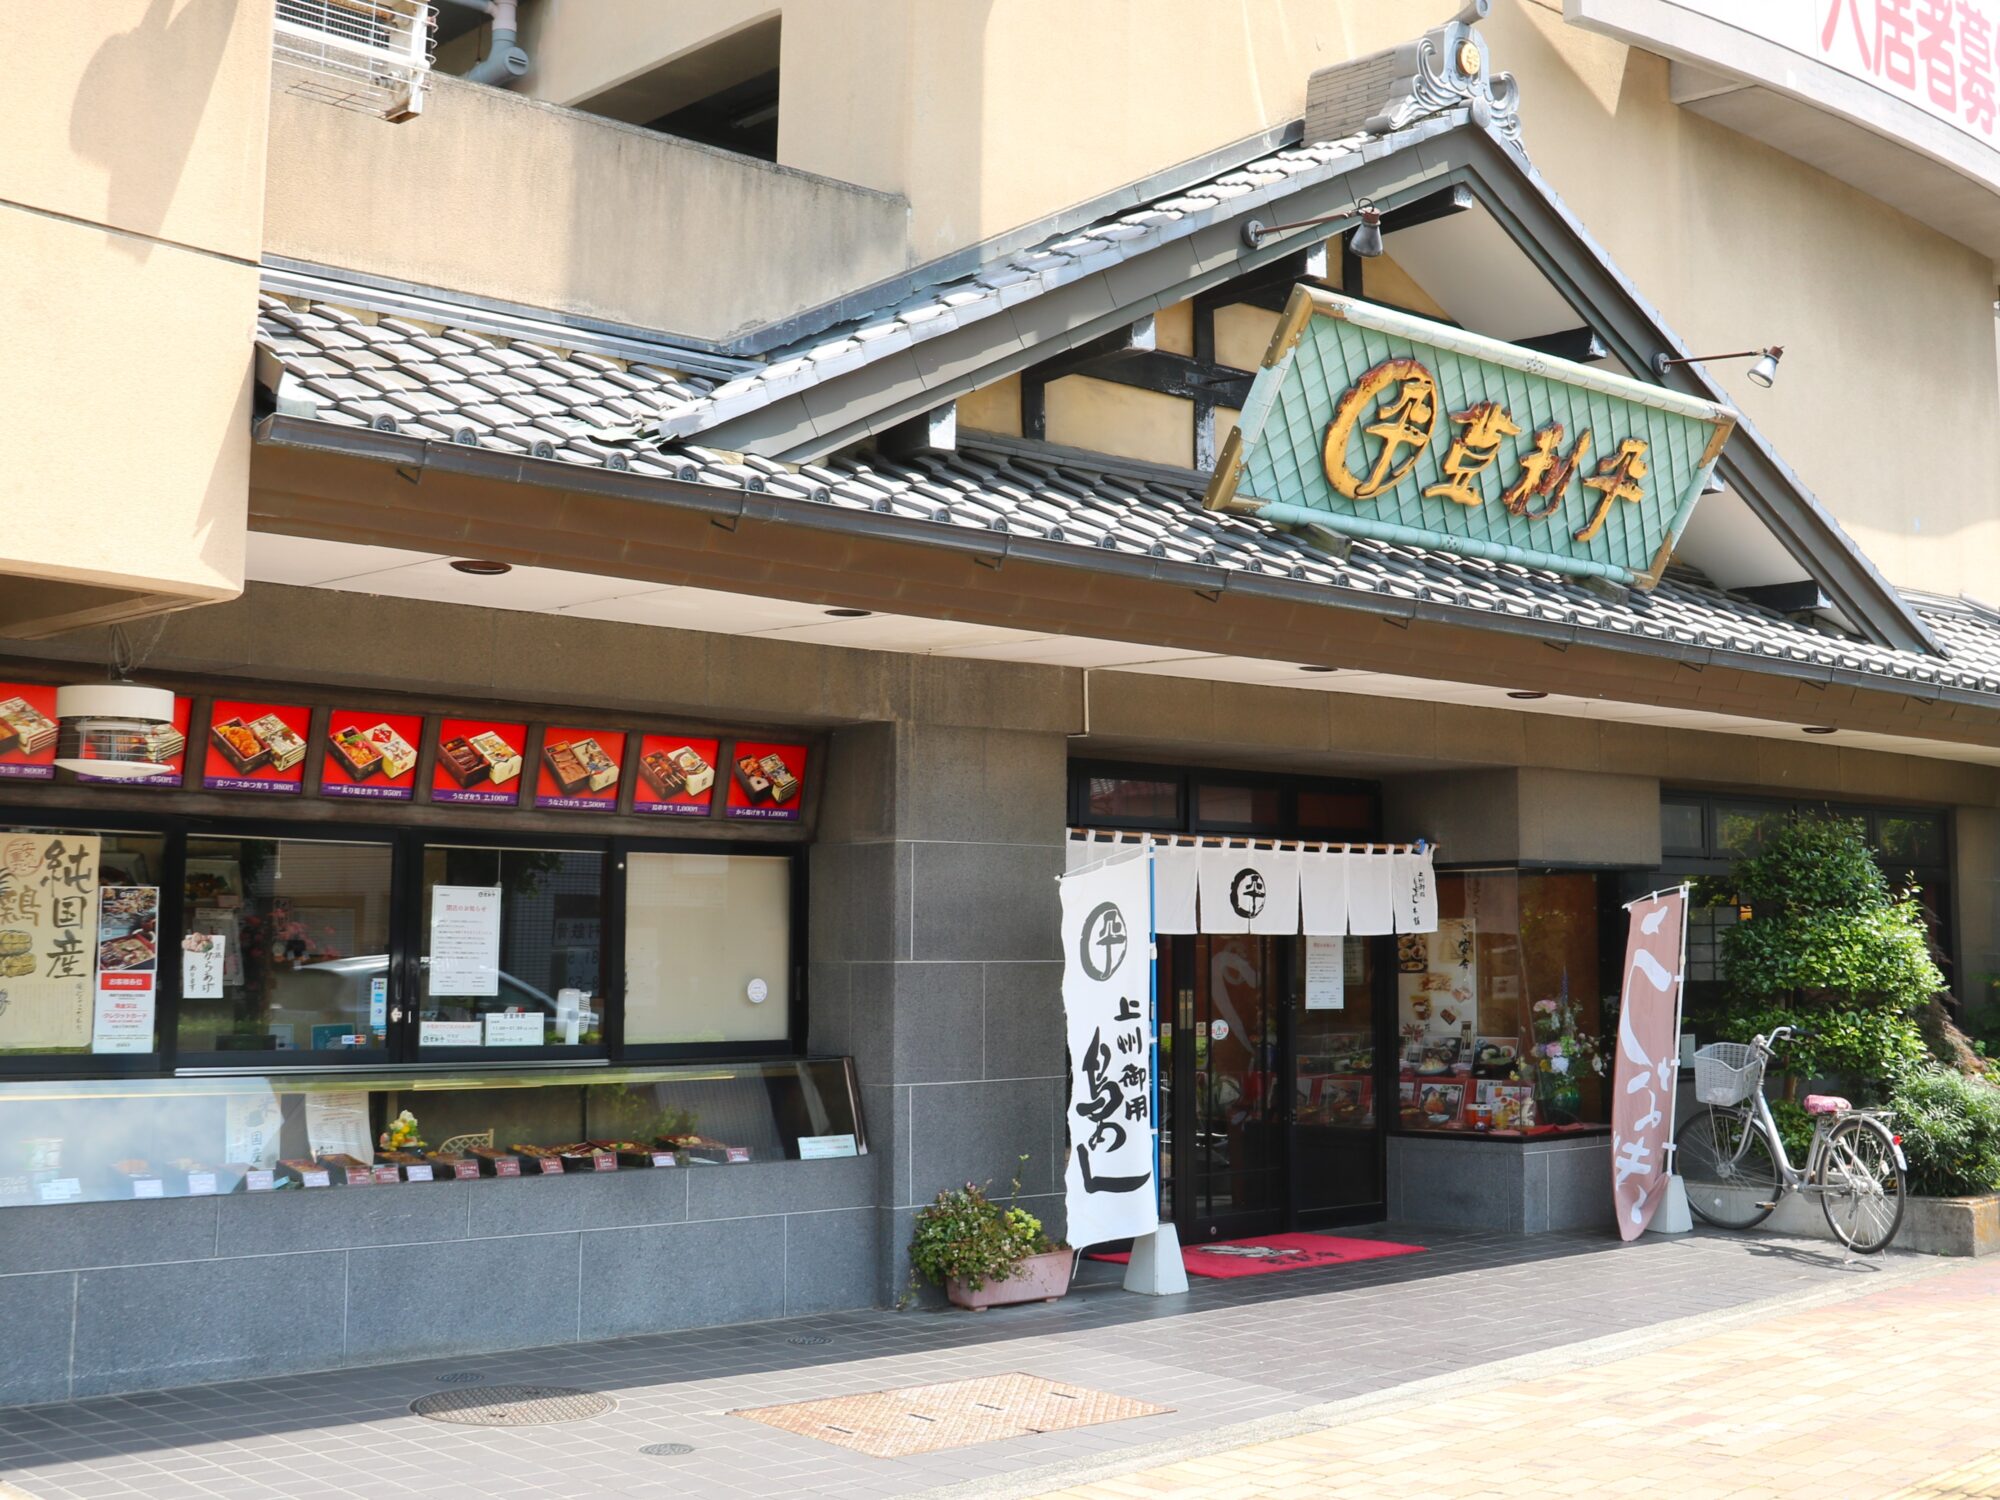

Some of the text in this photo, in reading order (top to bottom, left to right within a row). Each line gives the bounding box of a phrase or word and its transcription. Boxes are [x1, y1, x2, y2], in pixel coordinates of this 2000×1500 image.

[1821, 0, 2000, 135] 入居者募
[40, 839, 94, 979] 純国産
[1076, 1025, 1151, 1194] 鳥めし
[1114, 997, 1147, 1122] 上州御用
